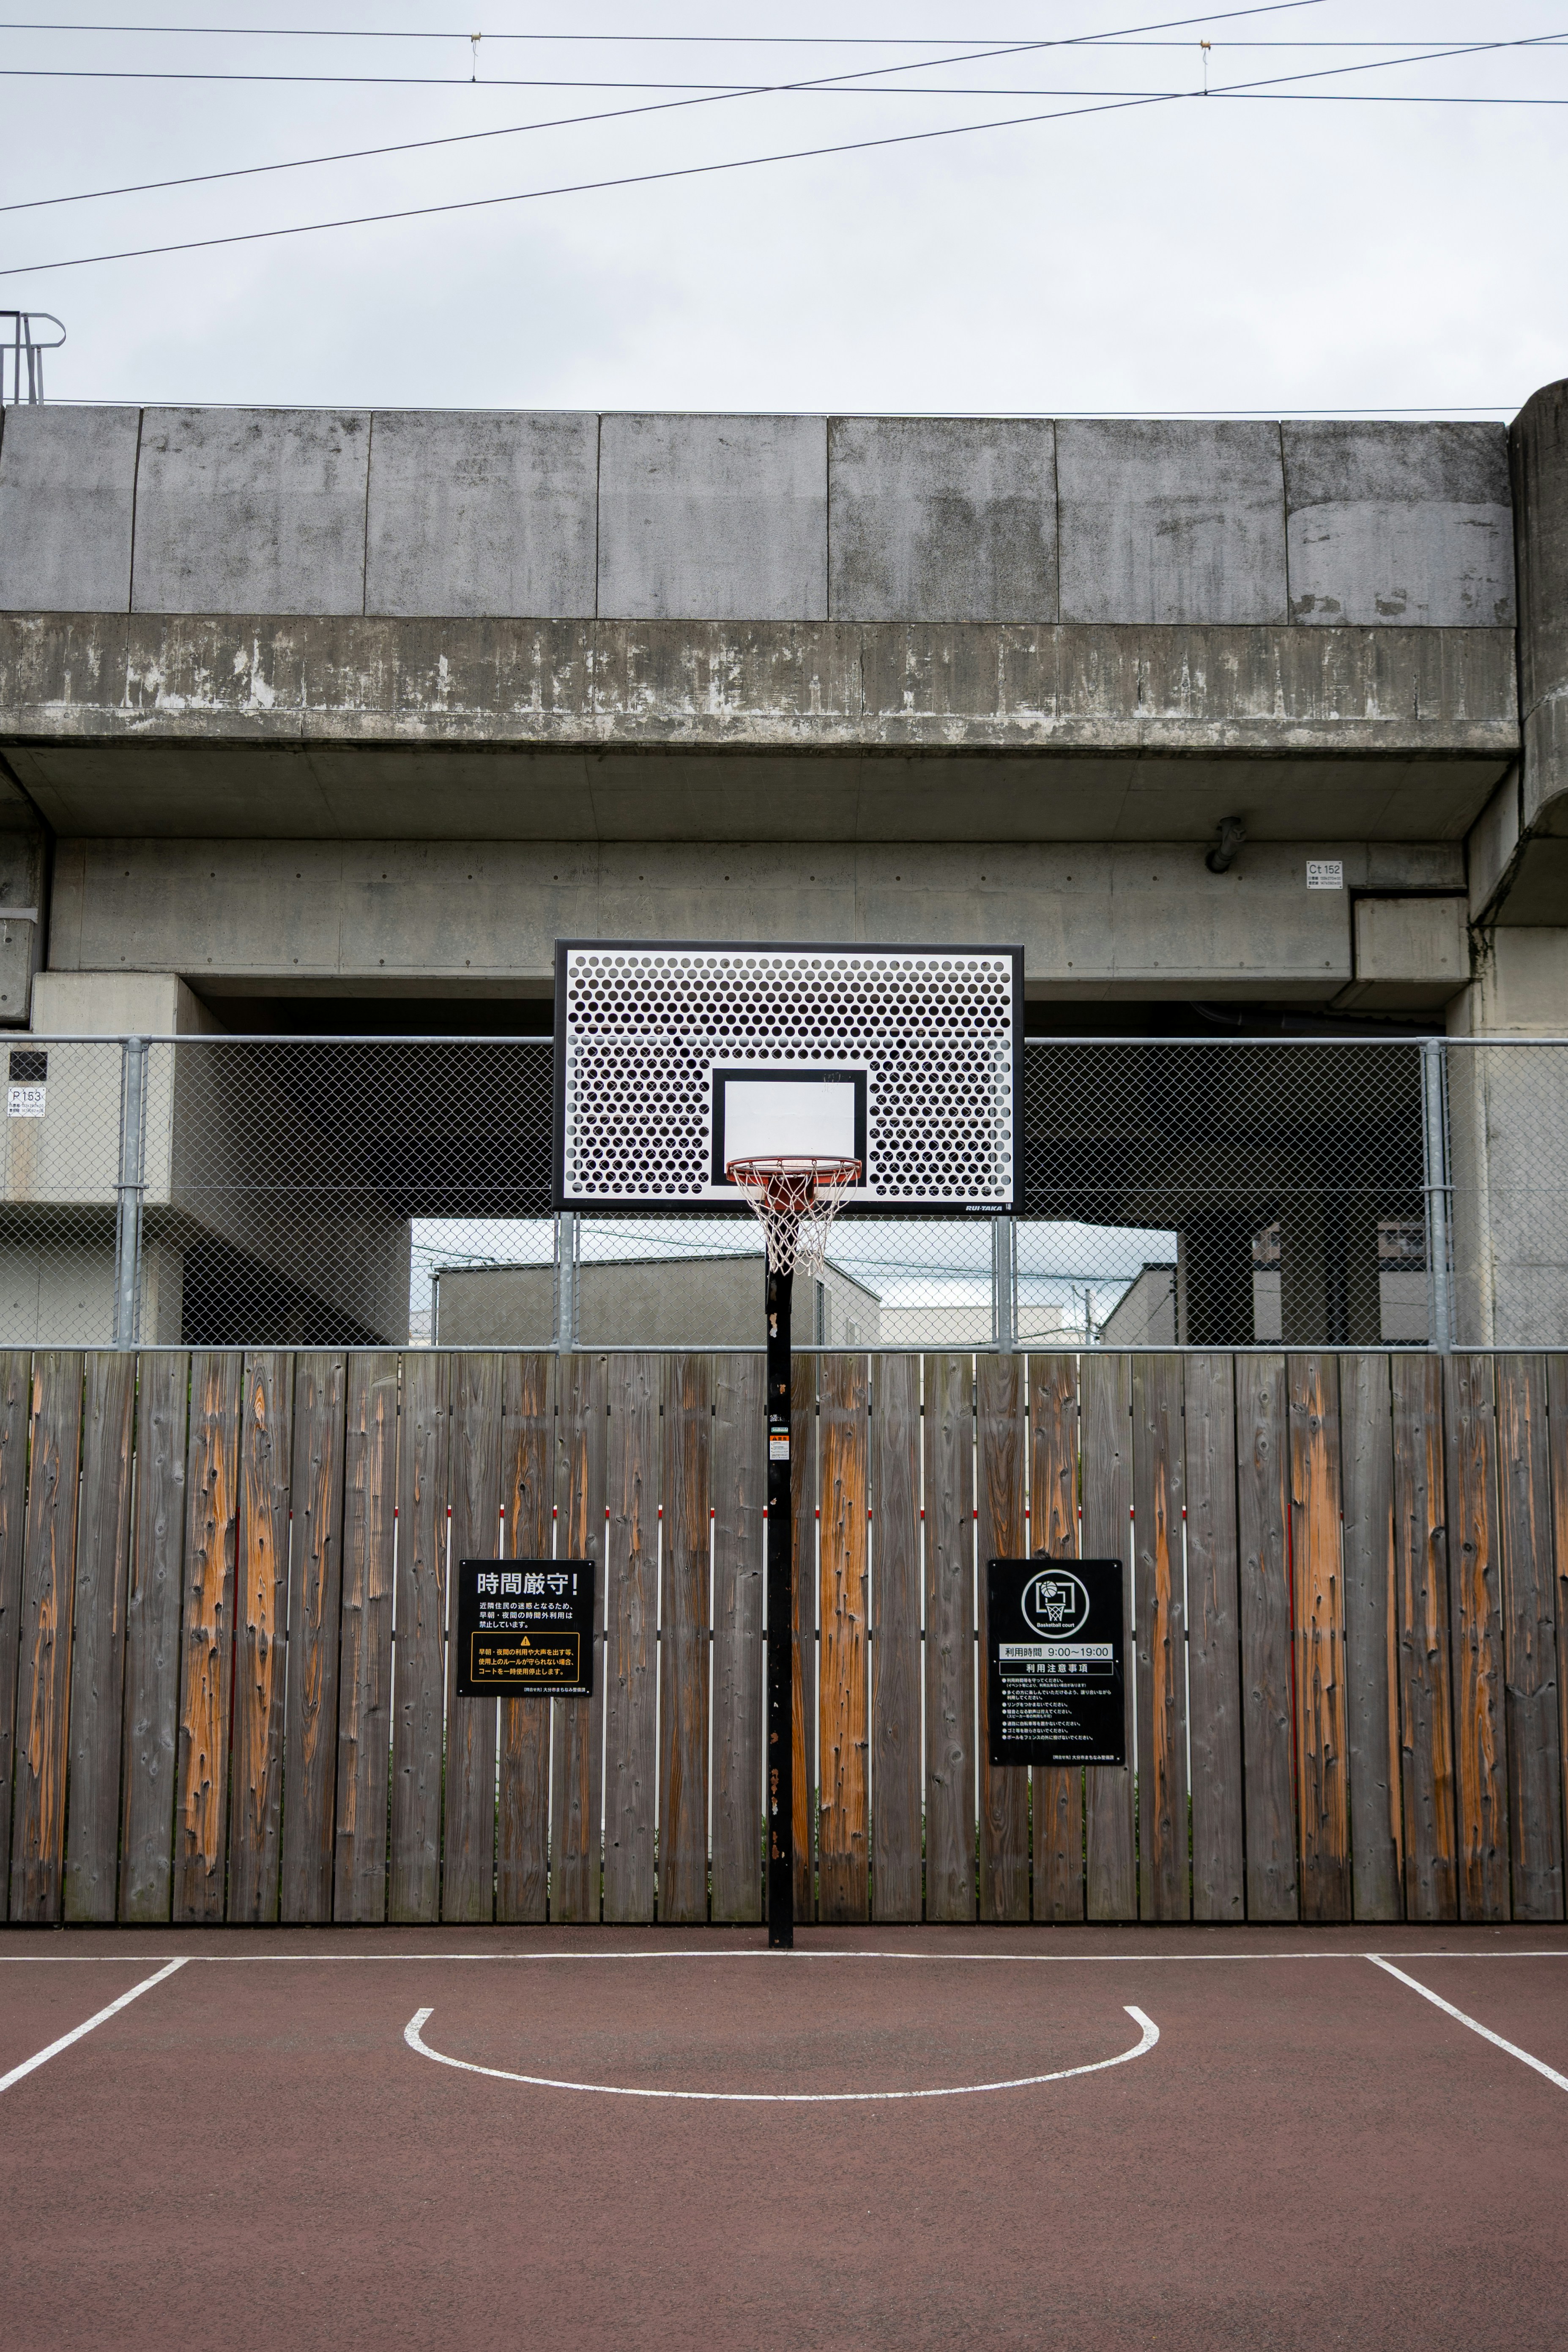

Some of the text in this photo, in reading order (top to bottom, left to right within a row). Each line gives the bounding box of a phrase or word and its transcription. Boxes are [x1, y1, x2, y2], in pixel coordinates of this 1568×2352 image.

[1309, 864, 1340, 874] Ct 152
[14, 1091, 41, 1101] P 153
[477, 1572, 577, 1595] 時間厳守!
[479, 1611, 573, 1619] 早朝・夜間の時間外利用は
[1005, 1647, 1108, 1657] 利用時間 9:00〜19:00
[1026, 1664, 1088, 1673] 利用注意事項
